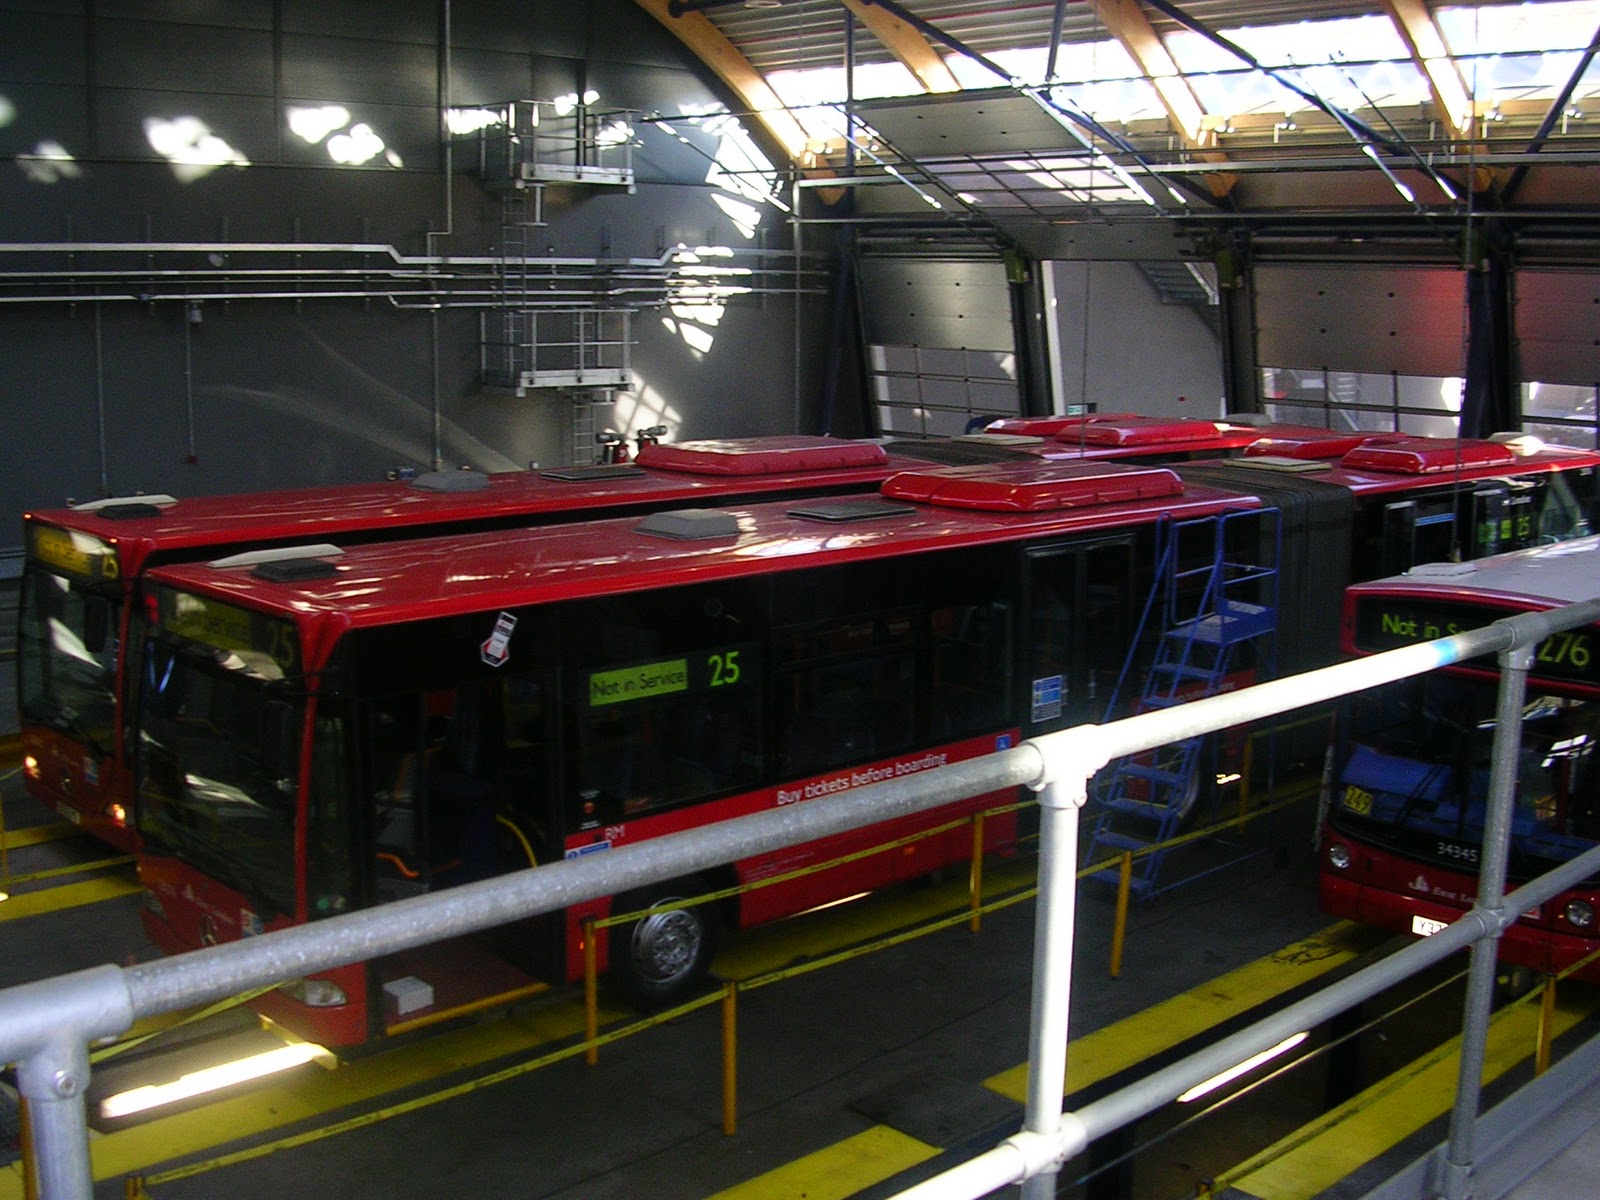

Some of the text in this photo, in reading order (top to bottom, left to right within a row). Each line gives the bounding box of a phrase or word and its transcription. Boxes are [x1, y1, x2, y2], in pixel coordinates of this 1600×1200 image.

[1381, 612, 1418, 638] Not
[1423, 621, 1441, 639] in
[1536, 631, 1591, 667] 276
[591, 650, 741, 697] Not in Service 25
[776, 752, 948, 806] Buy tickets before boarding
[1436, 841, 1479, 863] 34345
